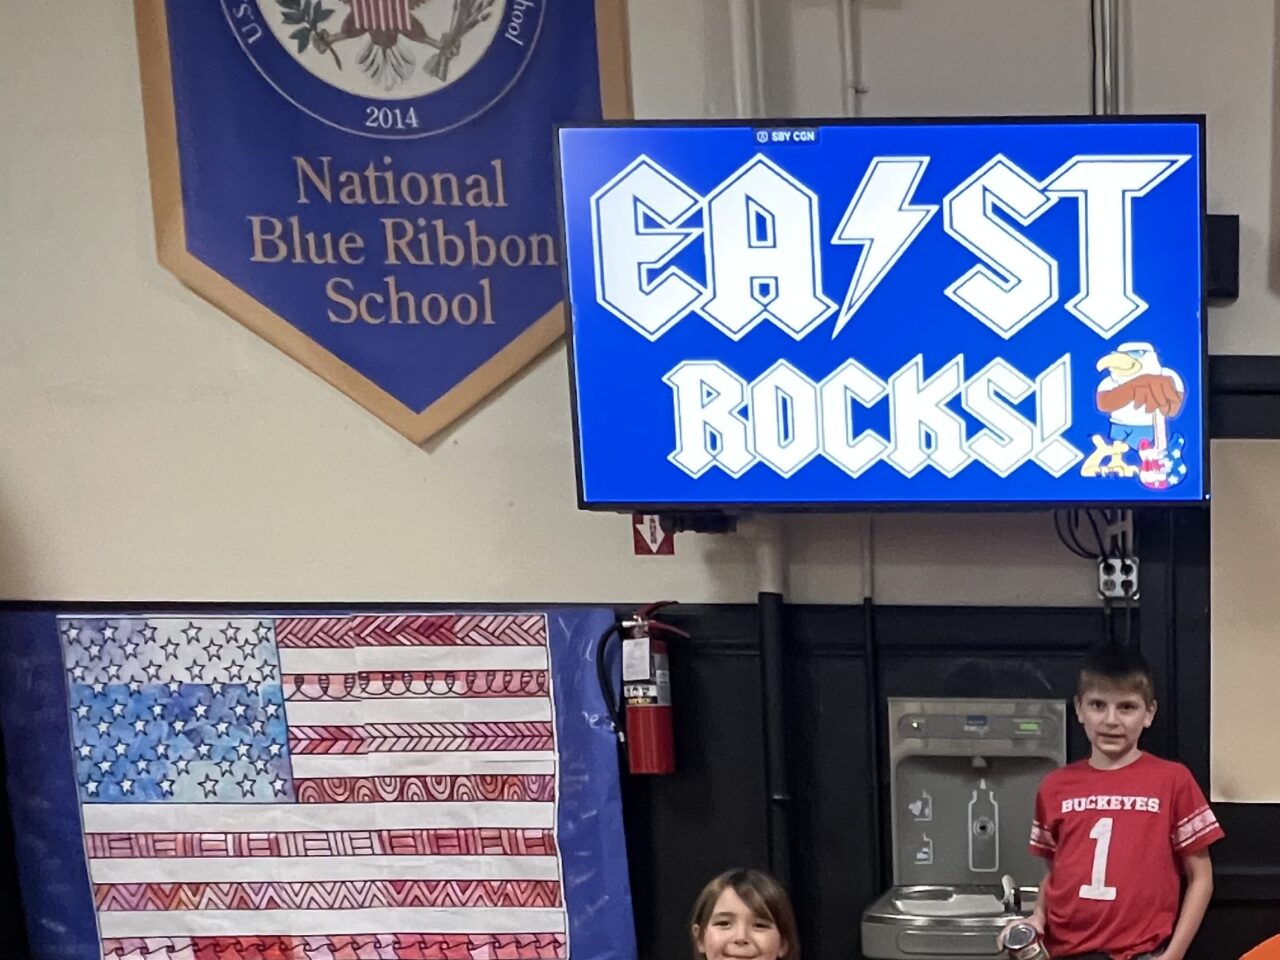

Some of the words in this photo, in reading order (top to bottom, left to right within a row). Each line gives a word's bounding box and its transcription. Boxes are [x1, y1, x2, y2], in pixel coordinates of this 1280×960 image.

[365, 106, 419, 130] 2014
[292, 155, 508, 209] National
[247, 215, 366, 265] Blue
[382, 218, 559, 268] Ribbon
[325, 277, 496, 325] School
[661, 353, 1084, 478] ROCKS!
[1061, 795, 1160, 813] BUCKEYES
[1078, 817, 1118, 901] 1
